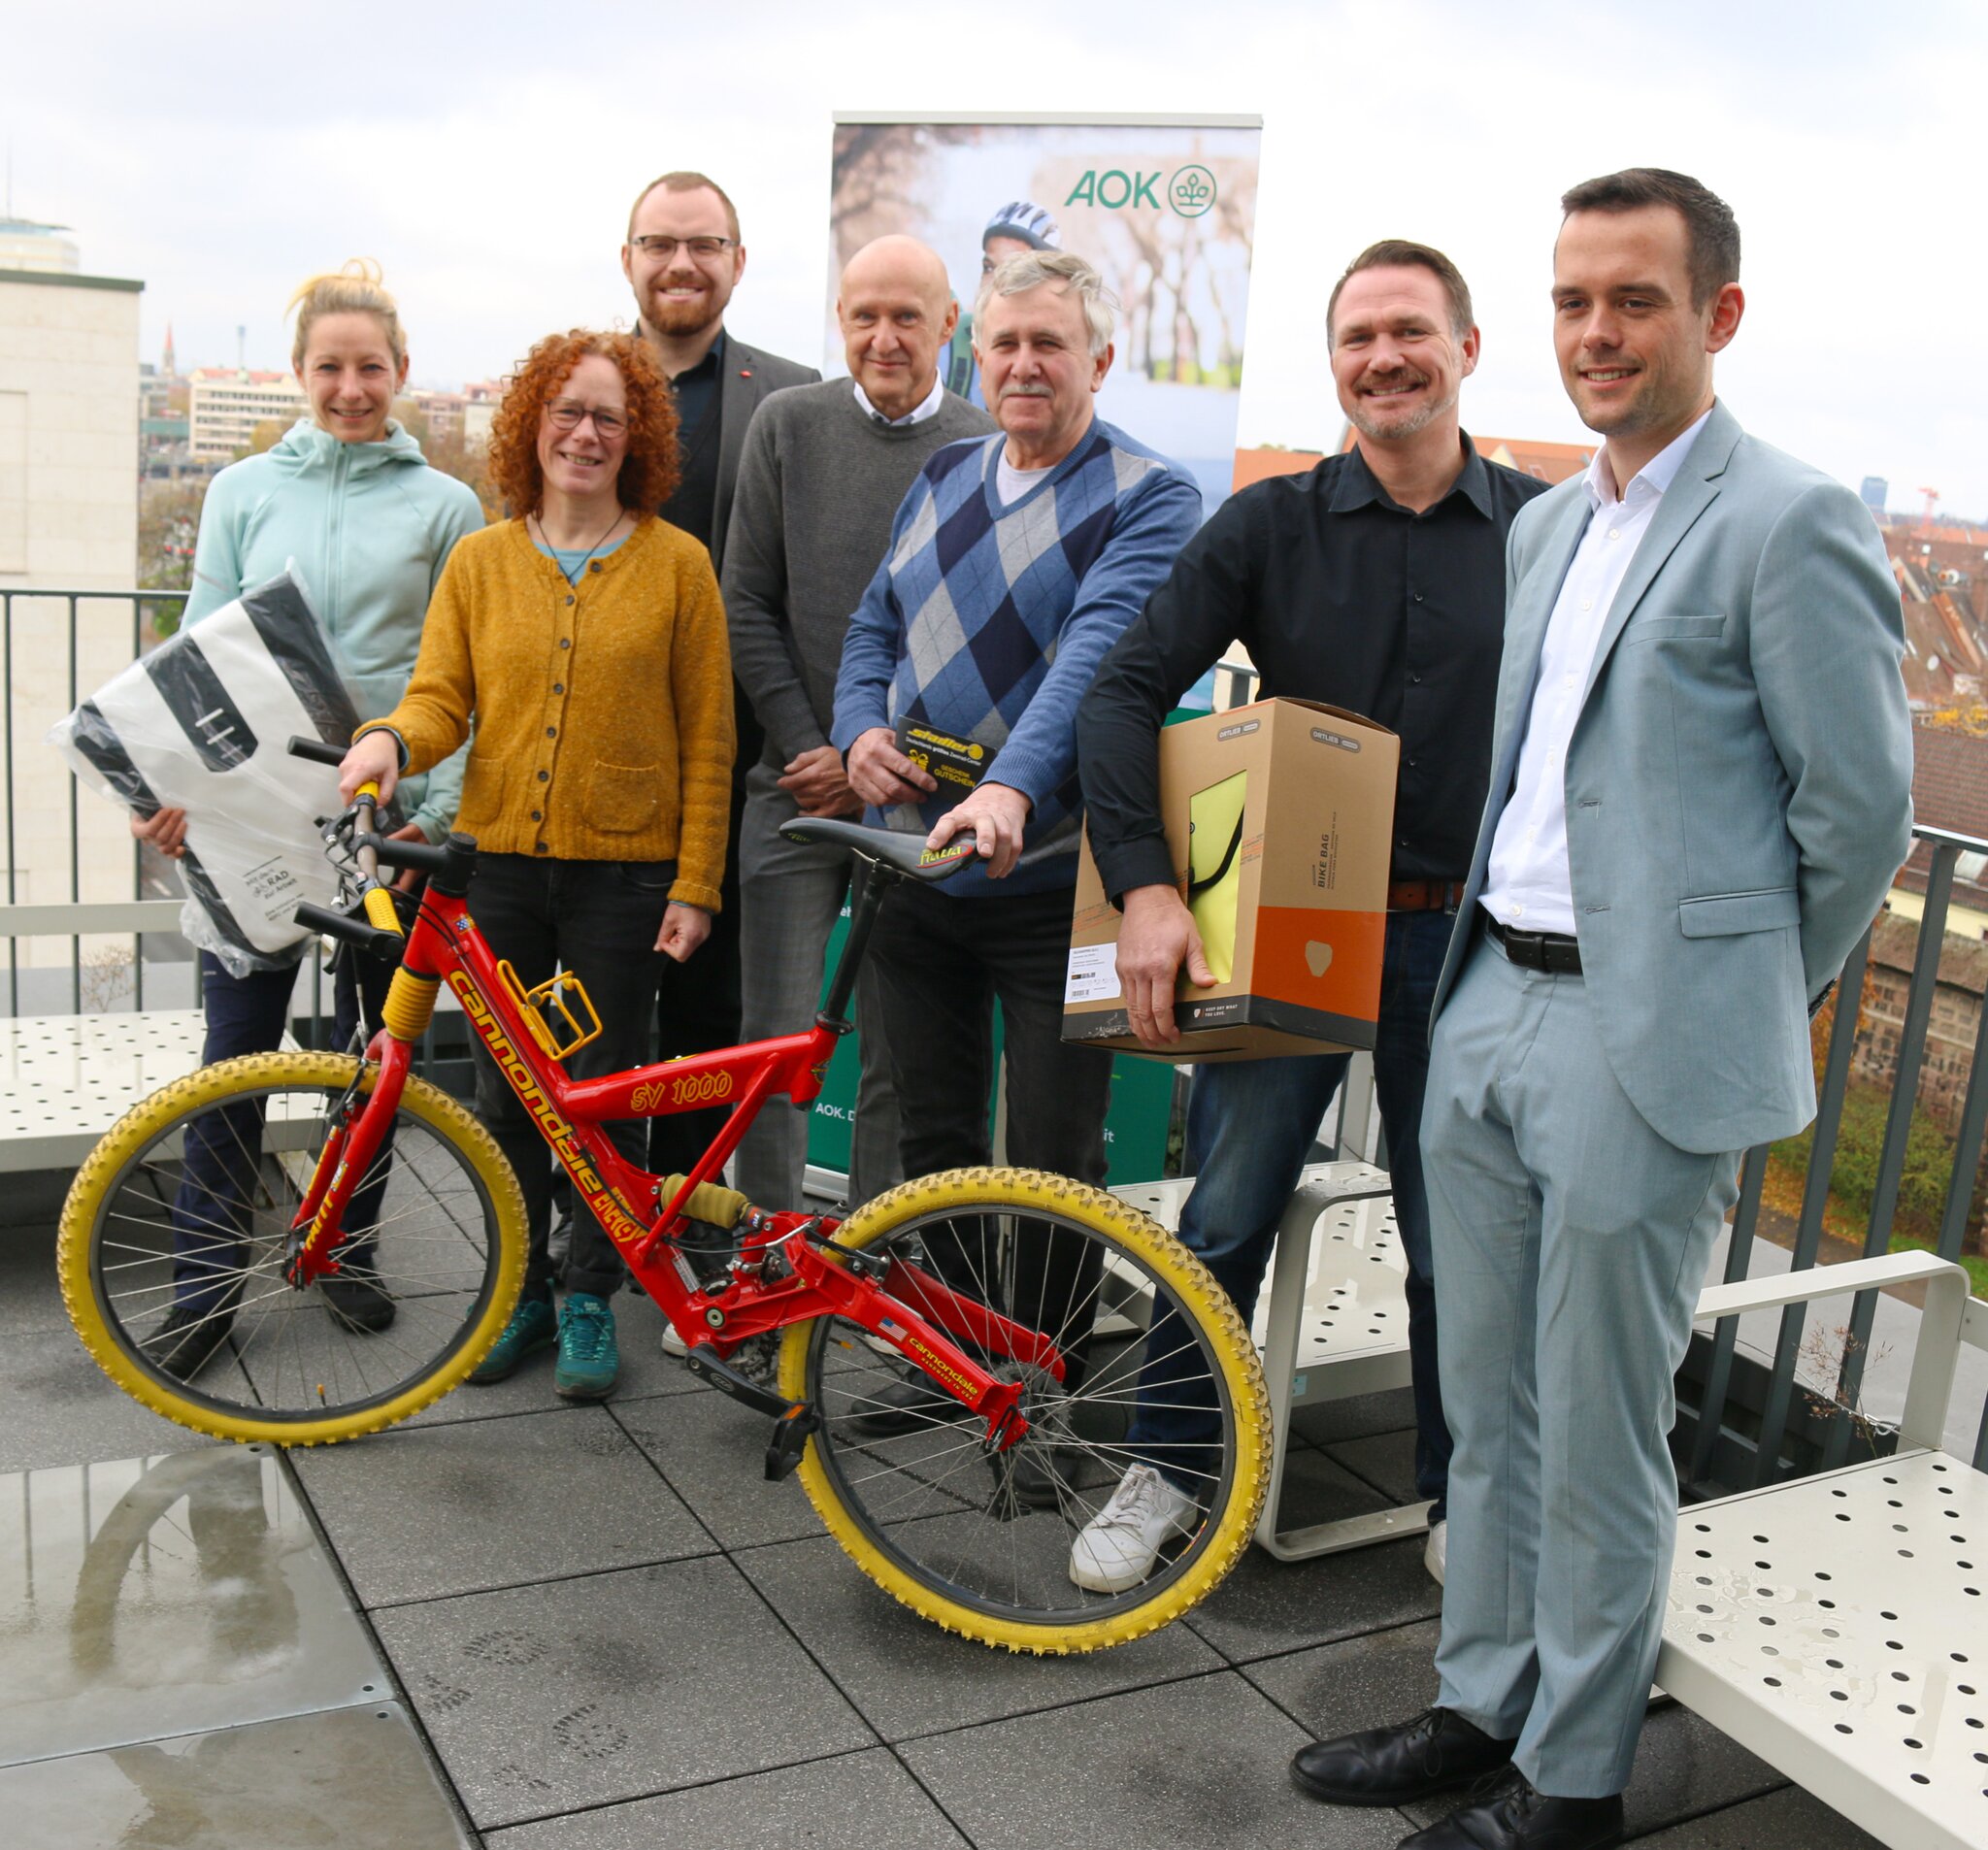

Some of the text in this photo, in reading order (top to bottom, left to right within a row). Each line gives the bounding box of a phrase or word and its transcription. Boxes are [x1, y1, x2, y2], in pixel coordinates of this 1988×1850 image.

[1064, 170, 1162, 209] AOK
[1219, 727, 1242, 738] ORTLIEB
[1313, 731, 1340, 744] ORTLIEB
[934, 768, 977, 788] GUTSCHEIN
[267, 871, 289, 885] RAD
[1317, 834, 1330, 888] BIKE BAG
[449, 970, 603, 1194] cannondale
[631, 1070, 733, 1111] SV 1000
[815, 1103, 845, 1119] AOK.
[909, 1338, 977, 1396] cannondale
[921, 1358, 951, 1383] HANDMADE
[961, 1390, 974, 1401] USA
